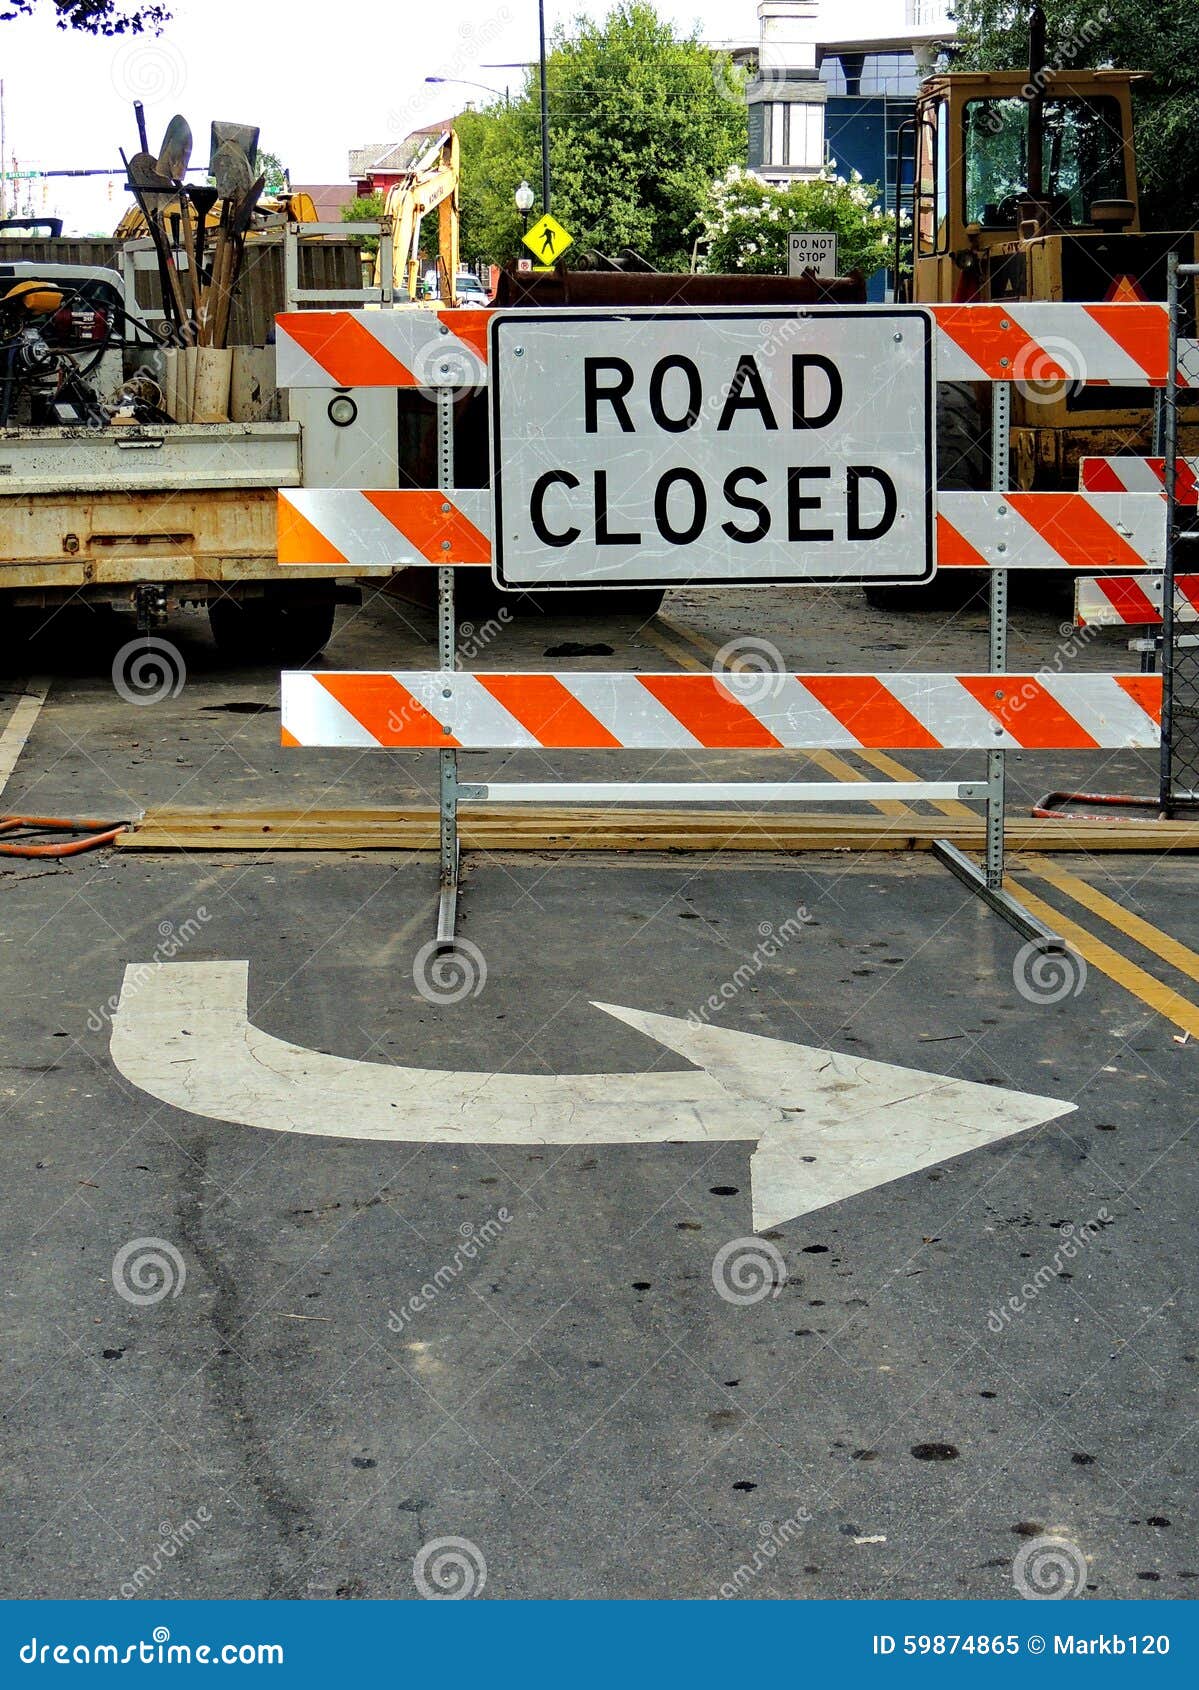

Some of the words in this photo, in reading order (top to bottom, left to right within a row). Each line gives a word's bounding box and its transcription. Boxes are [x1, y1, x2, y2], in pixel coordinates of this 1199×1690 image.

[792, 239, 808, 249] DO
[812, 239, 834, 249] NOT
[798, 252, 826, 262] STOP
[584, 354, 843, 433] ROAD
[529, 465, 898, 547] CLOSED
